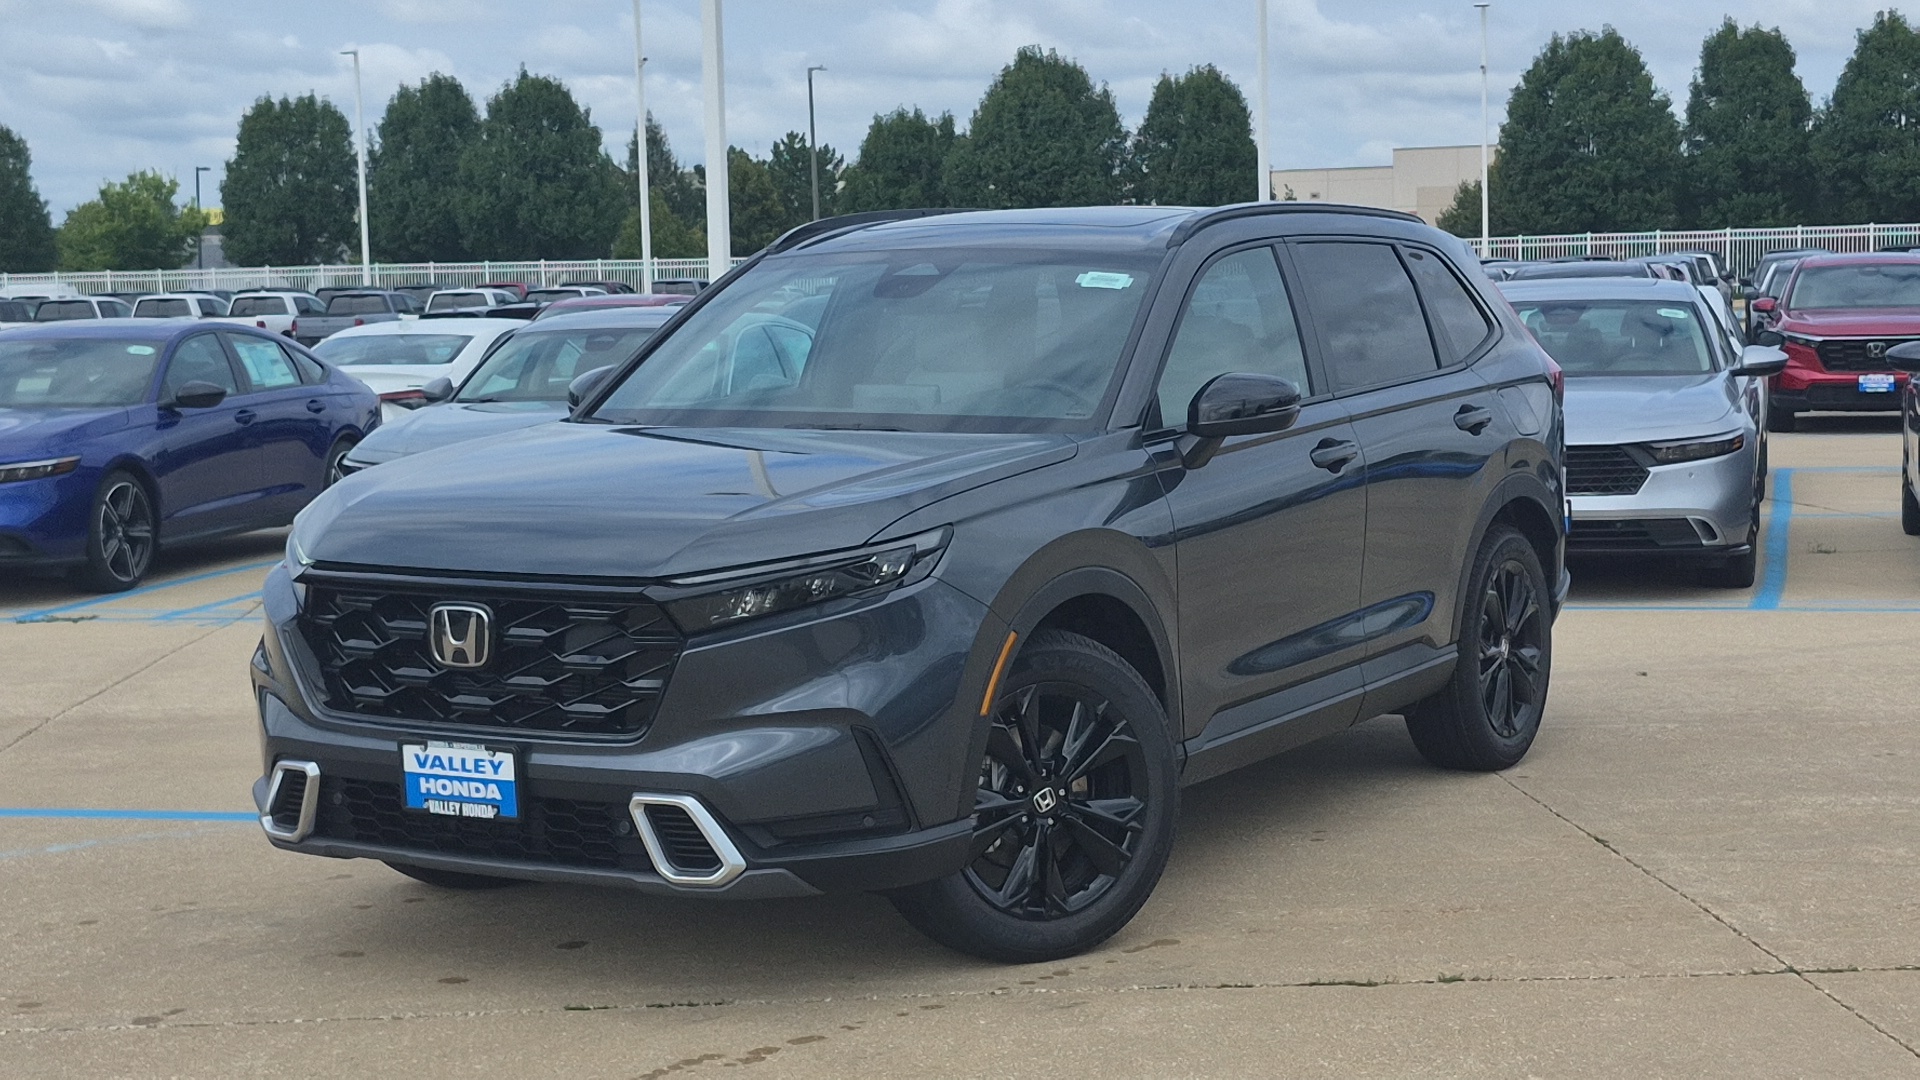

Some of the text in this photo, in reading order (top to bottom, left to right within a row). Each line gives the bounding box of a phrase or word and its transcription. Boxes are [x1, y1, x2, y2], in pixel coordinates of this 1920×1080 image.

[414, 753, 504, 775] VALLEY
[420, 777, 502, 800] HONDA
[429, 800, 494, 819] VALLEY HONDA
